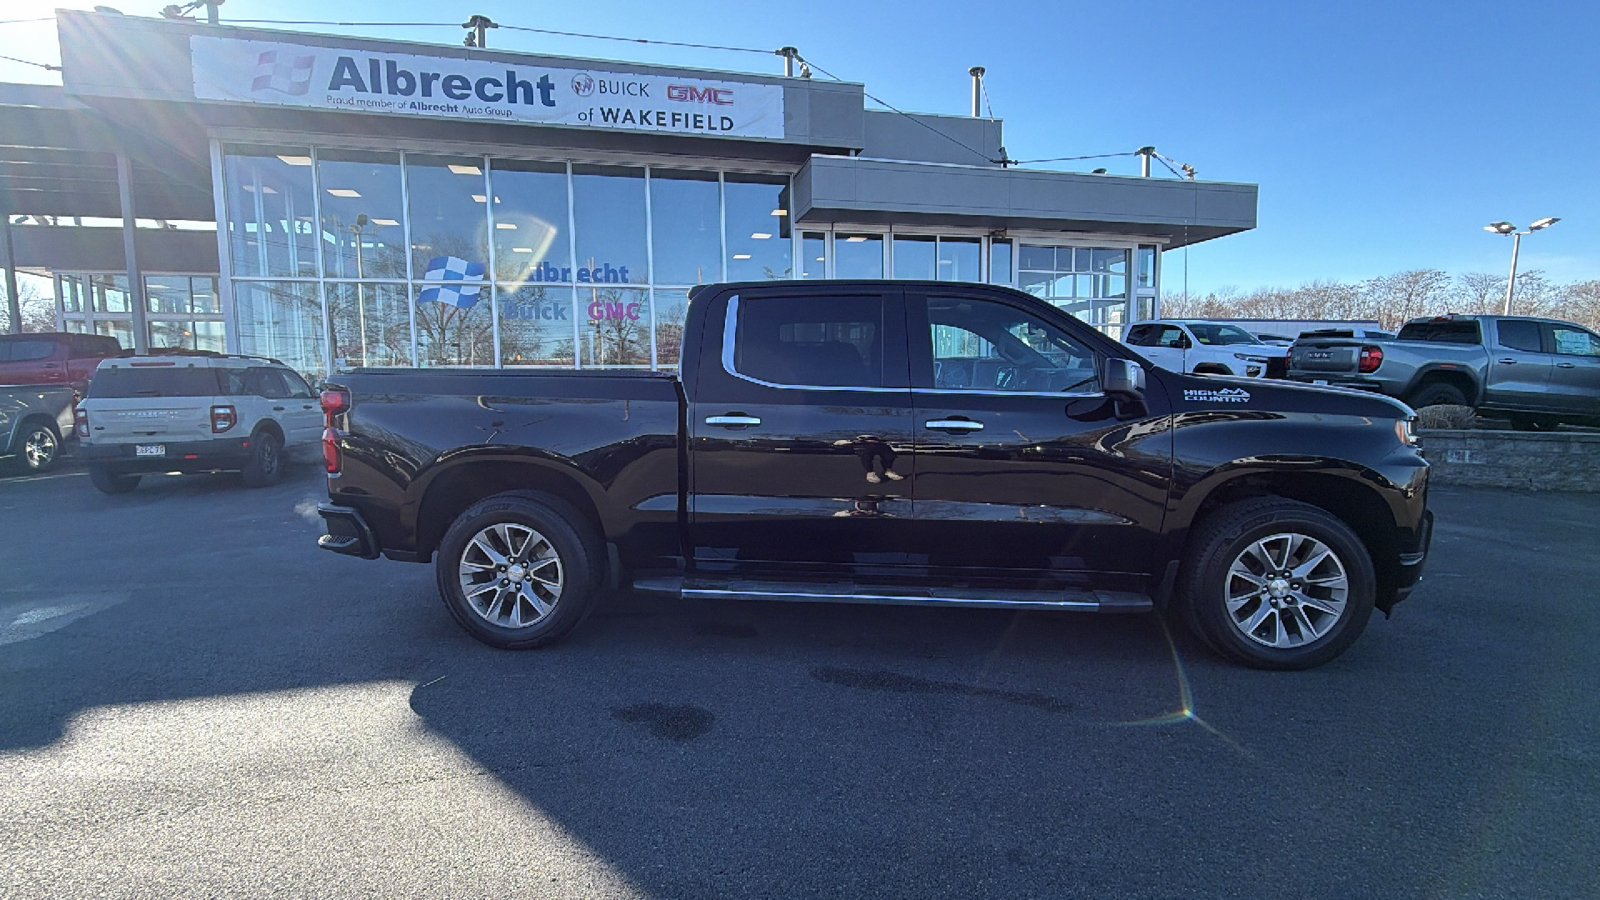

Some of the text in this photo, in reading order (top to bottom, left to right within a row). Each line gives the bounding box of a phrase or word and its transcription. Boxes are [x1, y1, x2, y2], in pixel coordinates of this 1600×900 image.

[328, 56, 556, 107] Albrecht
[599, 79, 734, 106] BUICK GMC
[326, 94, 513, 117] Proud member of Albrecht Auto Group
[577, 106, 734, 131] of WAKEFIELD
[519, 261, 628, 284] Albrecht
[505, 301, 641, 321] Buick GMC
